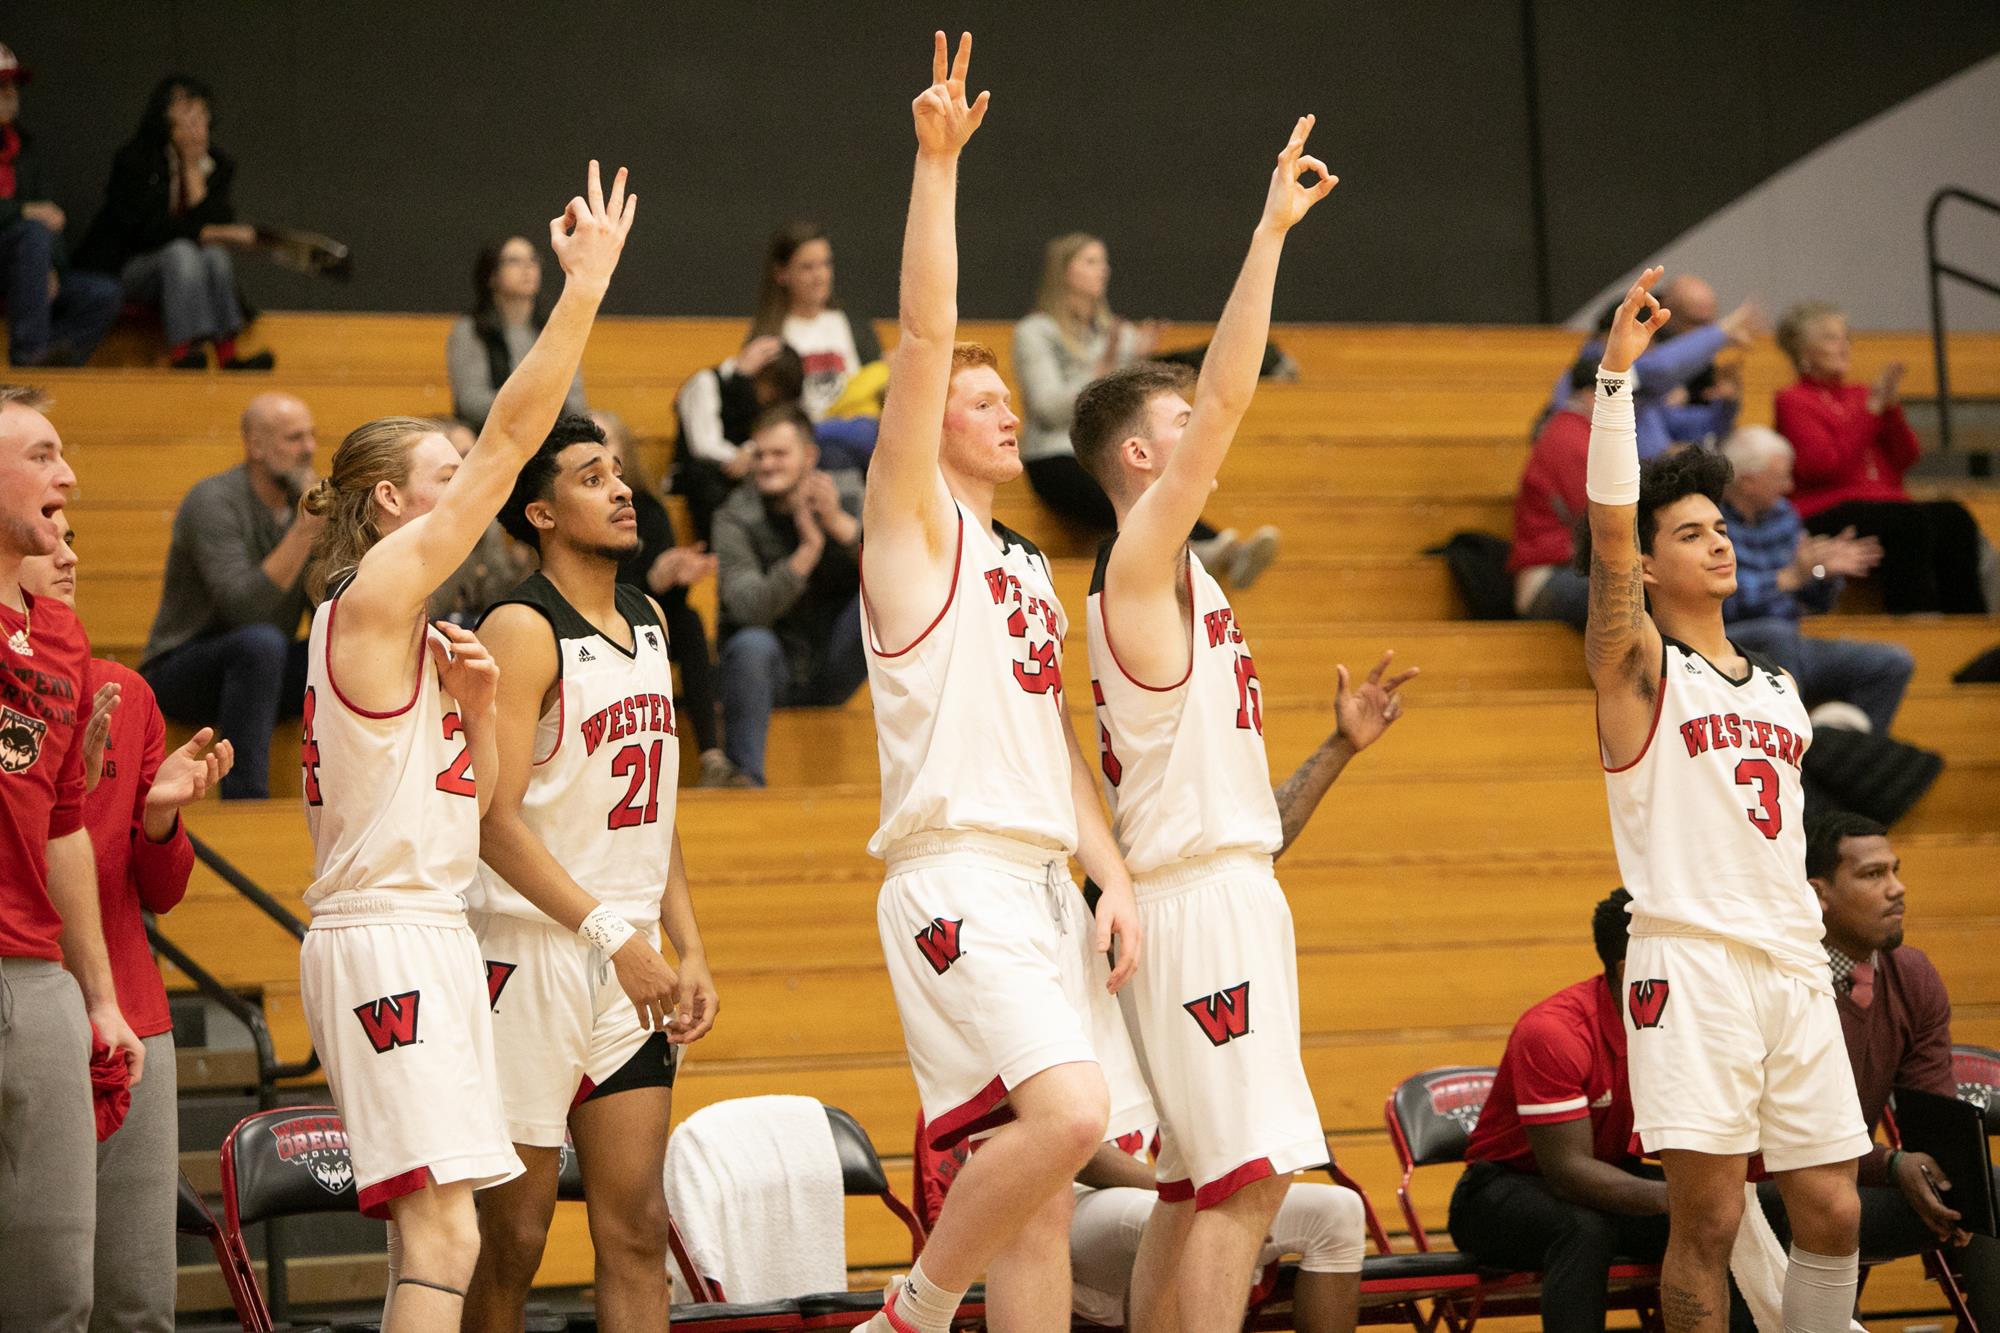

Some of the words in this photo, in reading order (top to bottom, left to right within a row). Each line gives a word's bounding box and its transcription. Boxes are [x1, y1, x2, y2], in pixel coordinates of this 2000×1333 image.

[581, 693, 679, 757] WESTER
[608, 739, 663, 831] 21
[1735, 758, 1783, 840] 3
[914, 917, 964, 976] W
[353, 989, 420, 1054] W
[1183, 980, 1249, 1047] W
[1629, 978, 1669, 1031] W
